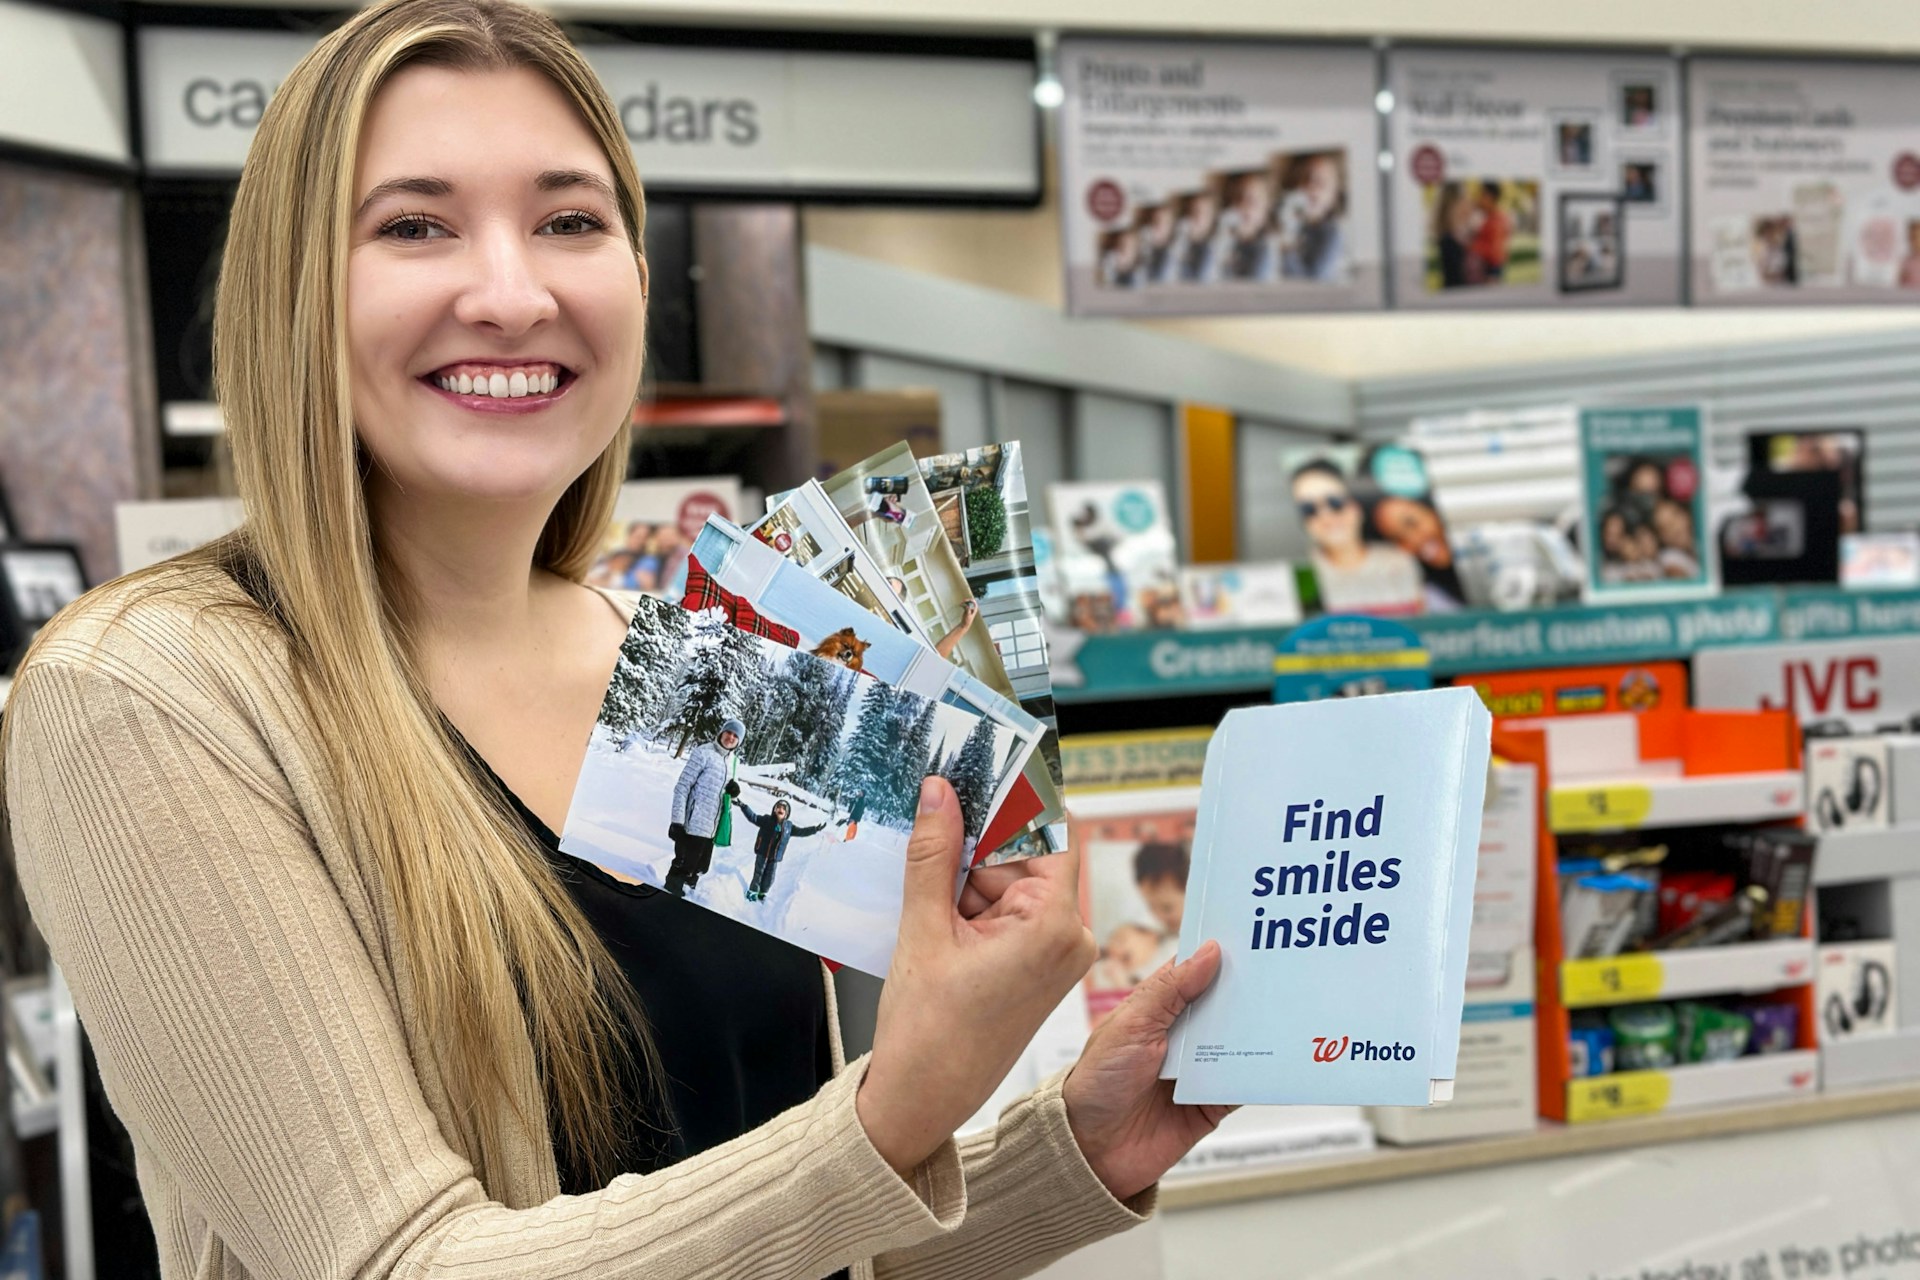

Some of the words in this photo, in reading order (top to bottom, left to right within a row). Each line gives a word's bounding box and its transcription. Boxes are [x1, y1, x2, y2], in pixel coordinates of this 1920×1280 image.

[183, 77, 267, 130] ca
[618, 80, 761, 147] dars
[1150, 636, 1275, 680] Create
[1547, 612, 1671, 654] custom
[1677, 604, 1772, 650] photo
[1760, 656, 1881, 715] JVC
[1283, 795, 1384, 843] Find
[1251, 850, 1402, 897] smiles
[1251, 903, 1390, 950] inside
[1350, 1040, 1416, 1061] Photo
[1779, 1245, 1832, 1279] the
